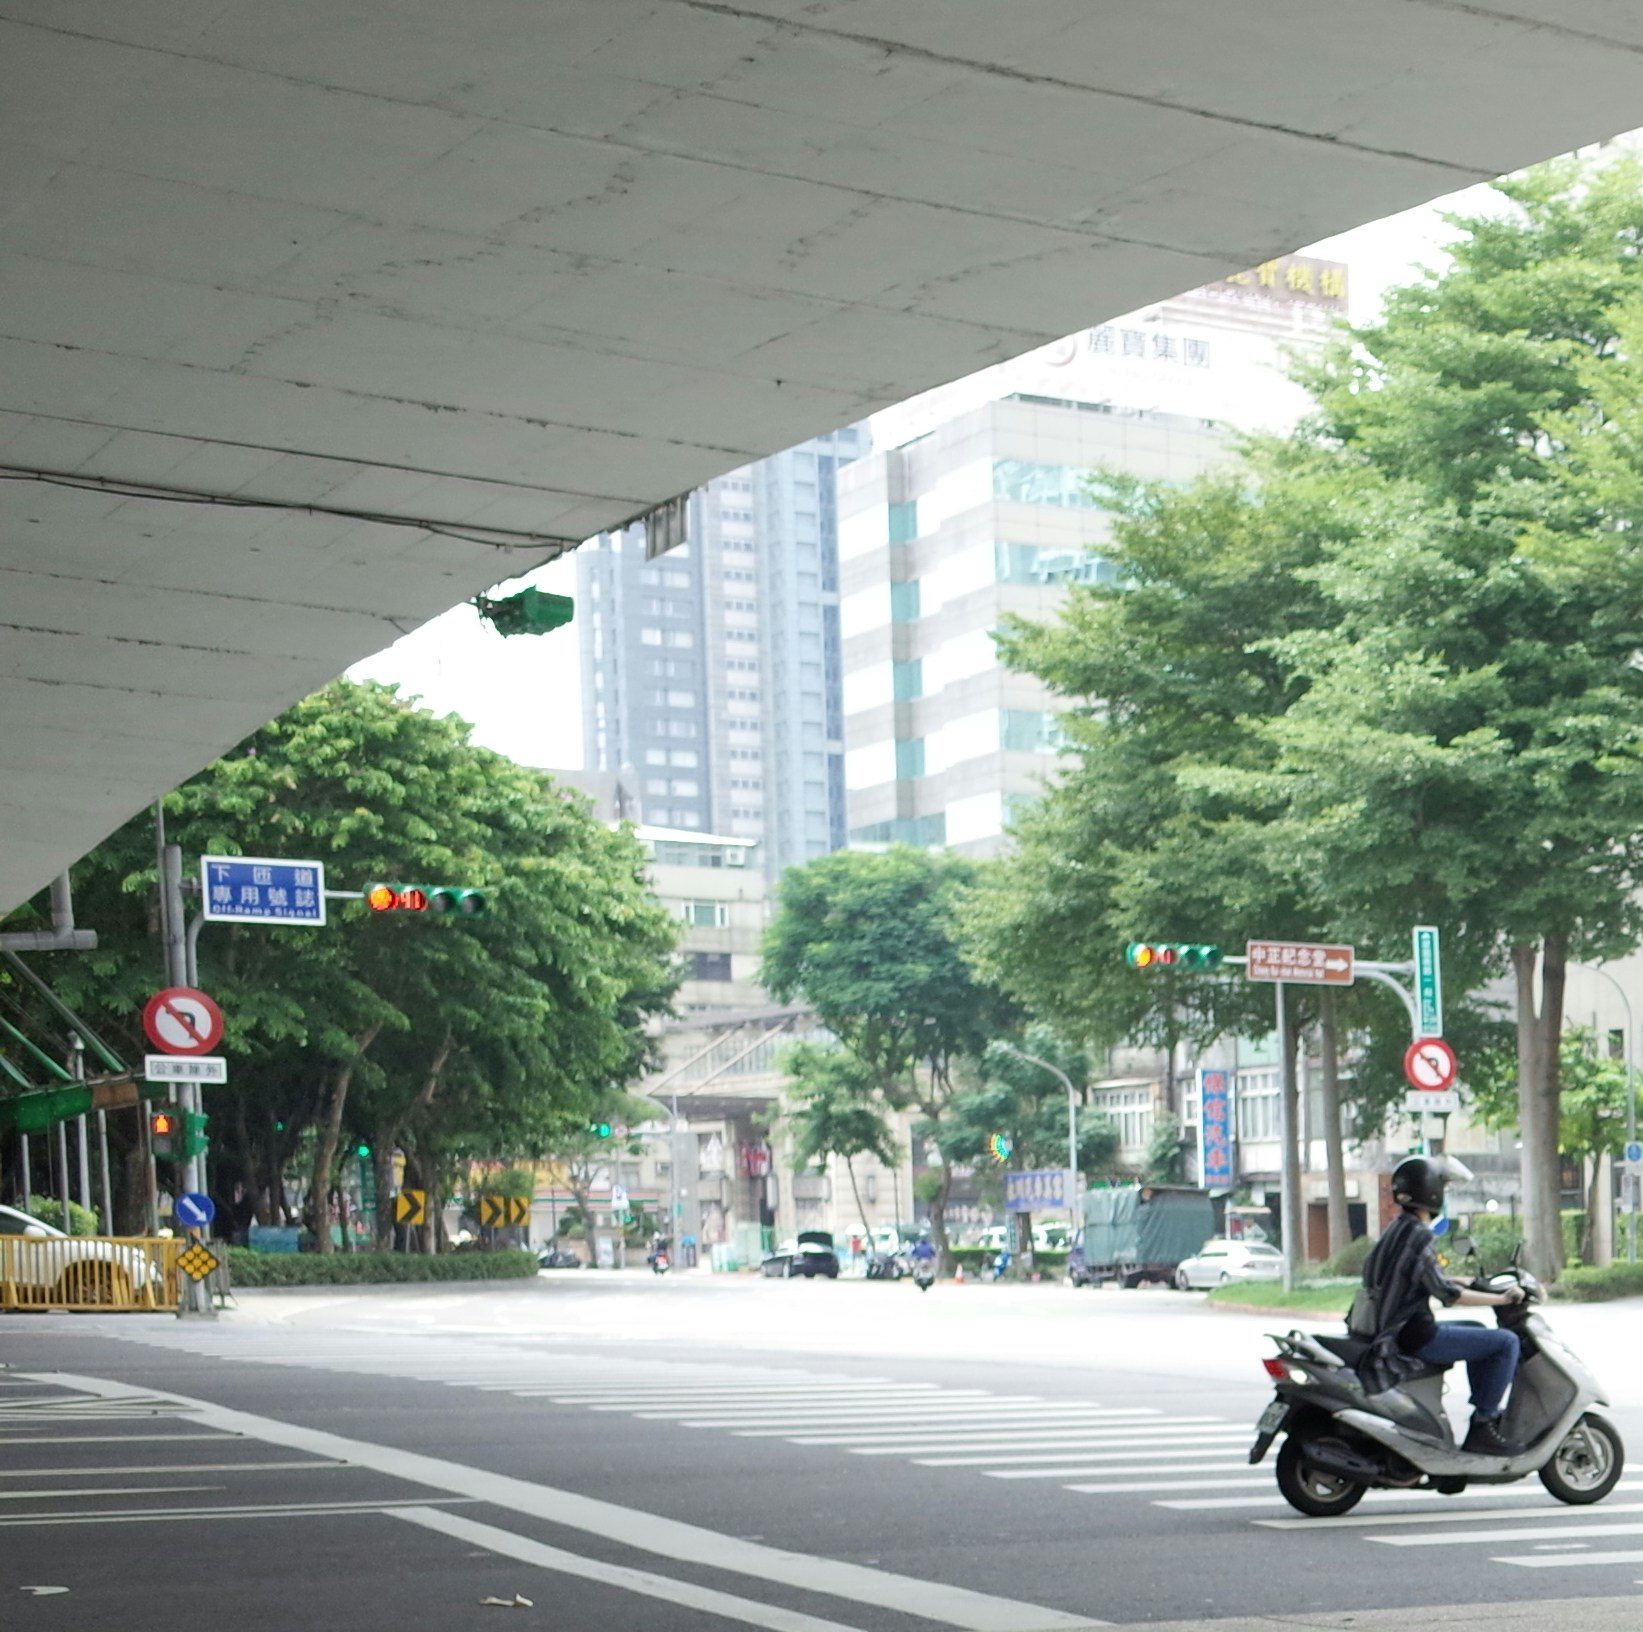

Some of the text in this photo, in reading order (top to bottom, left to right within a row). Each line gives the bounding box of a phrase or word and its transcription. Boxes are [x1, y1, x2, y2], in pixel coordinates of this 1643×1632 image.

[212, 884, 316, 908] 專用號誌
[1251, 947, 1328, 968] 中正紀念堂
